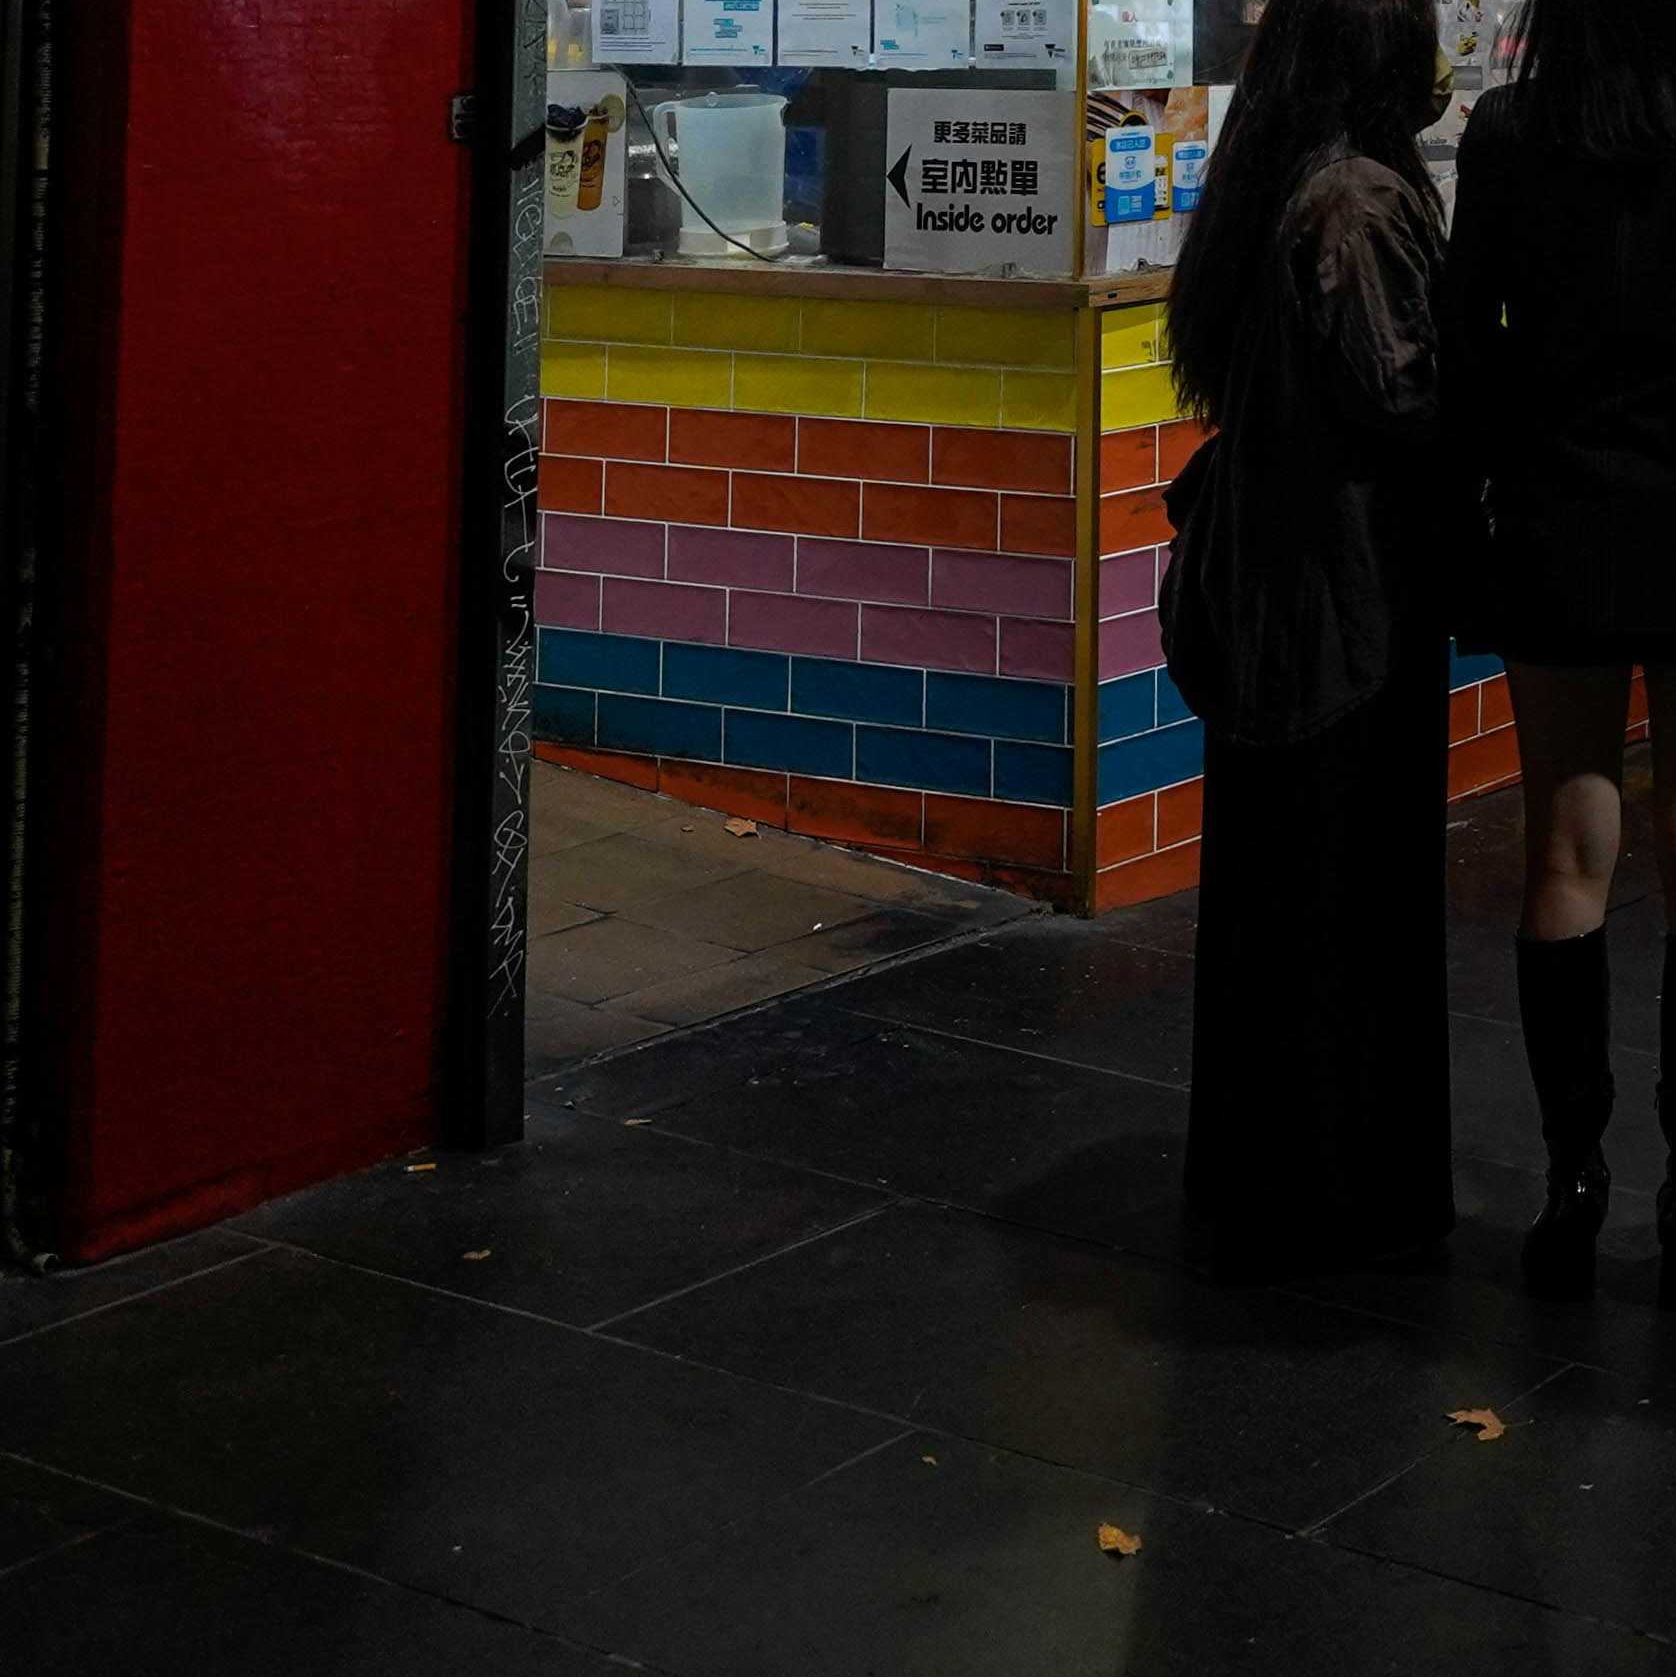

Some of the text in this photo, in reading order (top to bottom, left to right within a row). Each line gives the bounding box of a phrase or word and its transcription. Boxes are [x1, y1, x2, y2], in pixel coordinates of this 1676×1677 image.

[934, 120, 1027, 146] 更多菜品請
[915, 203, 1058, 237] Inside order
